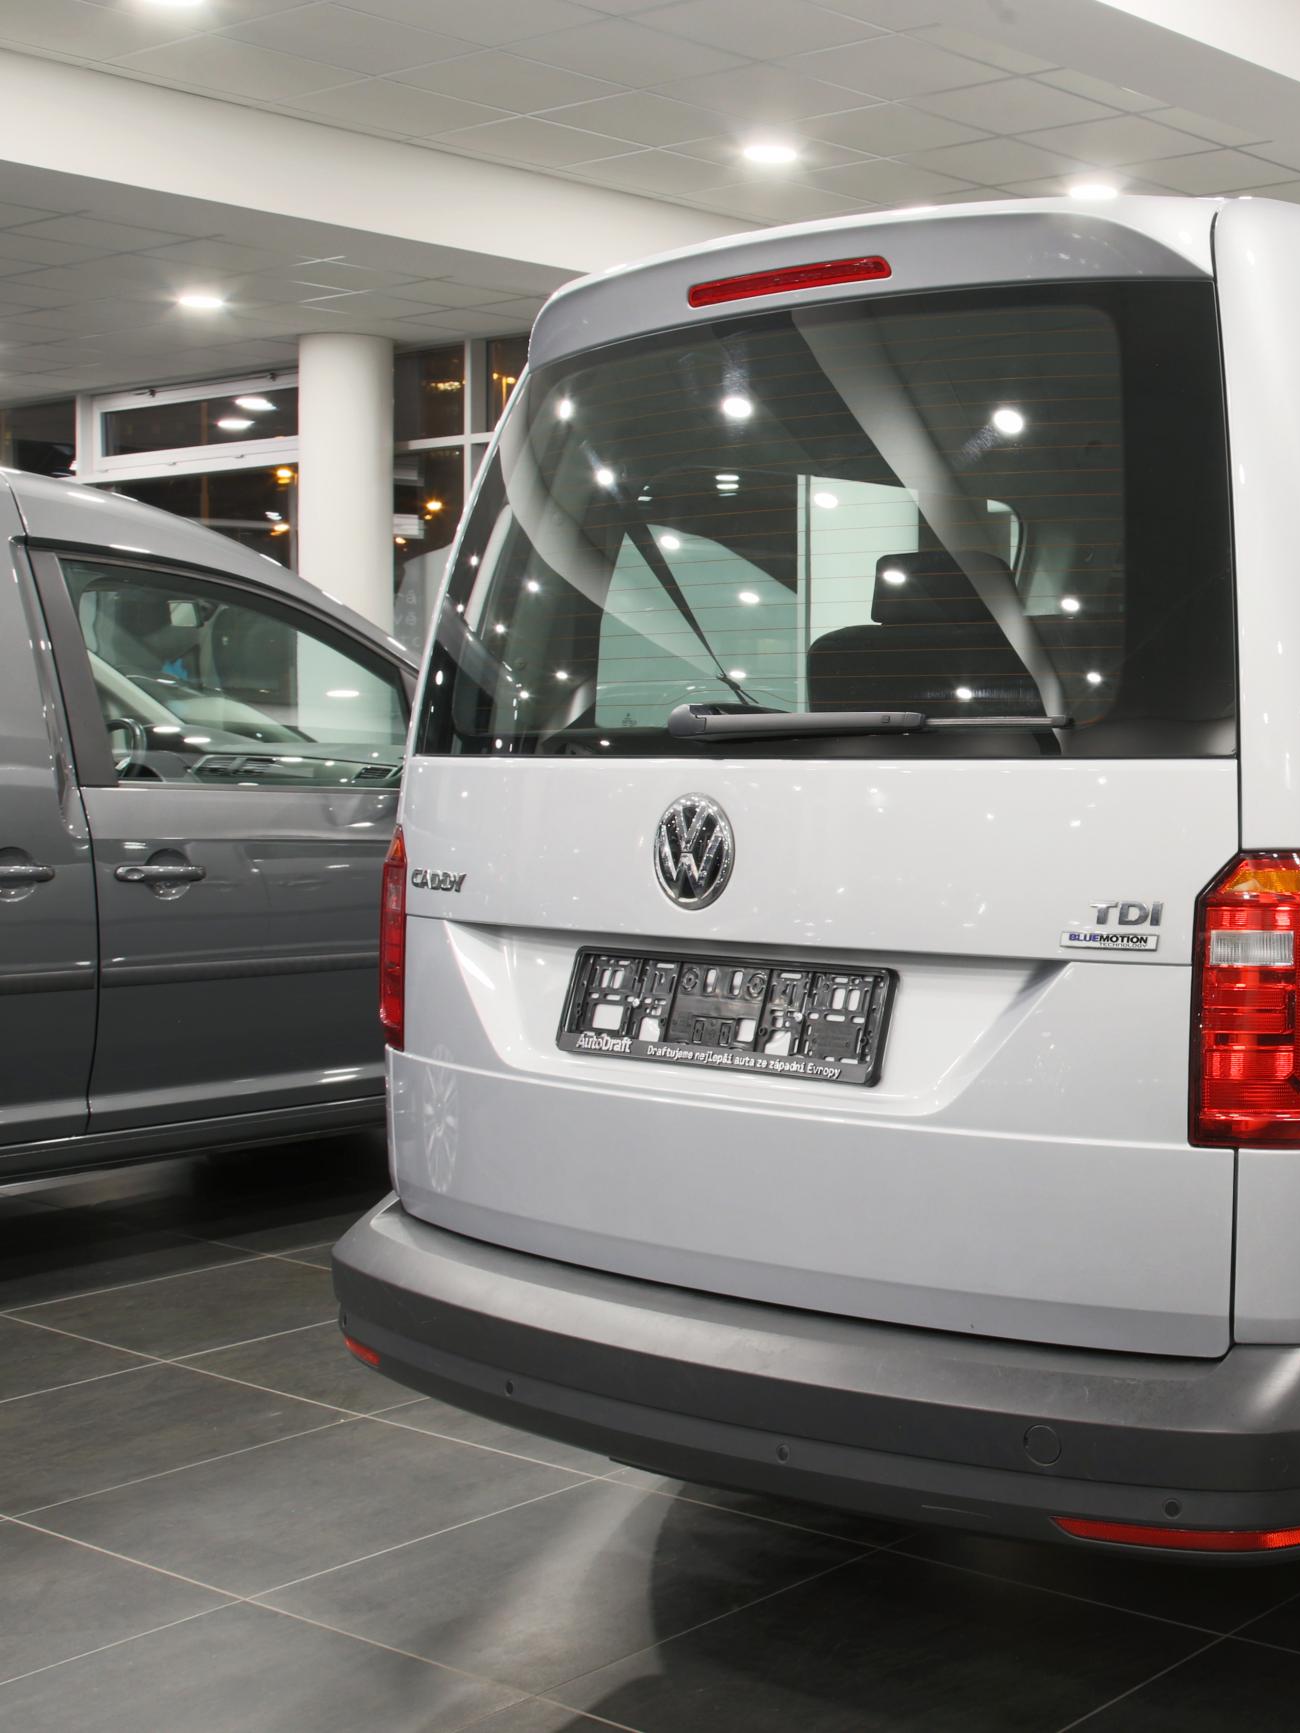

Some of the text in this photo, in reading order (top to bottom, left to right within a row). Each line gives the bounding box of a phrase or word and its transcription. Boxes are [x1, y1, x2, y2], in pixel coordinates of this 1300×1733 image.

[411, 868, 467, 893] CADDY
[1089, 901, 1164, 926] TDI
[1068, 933, 1148, 944] BLUEMOTION
[575, 1032, 632, 1053] AutoDraft
[647, 1045, 842, 1079] Draftujeme nejlepší auta ze západní Evropy
